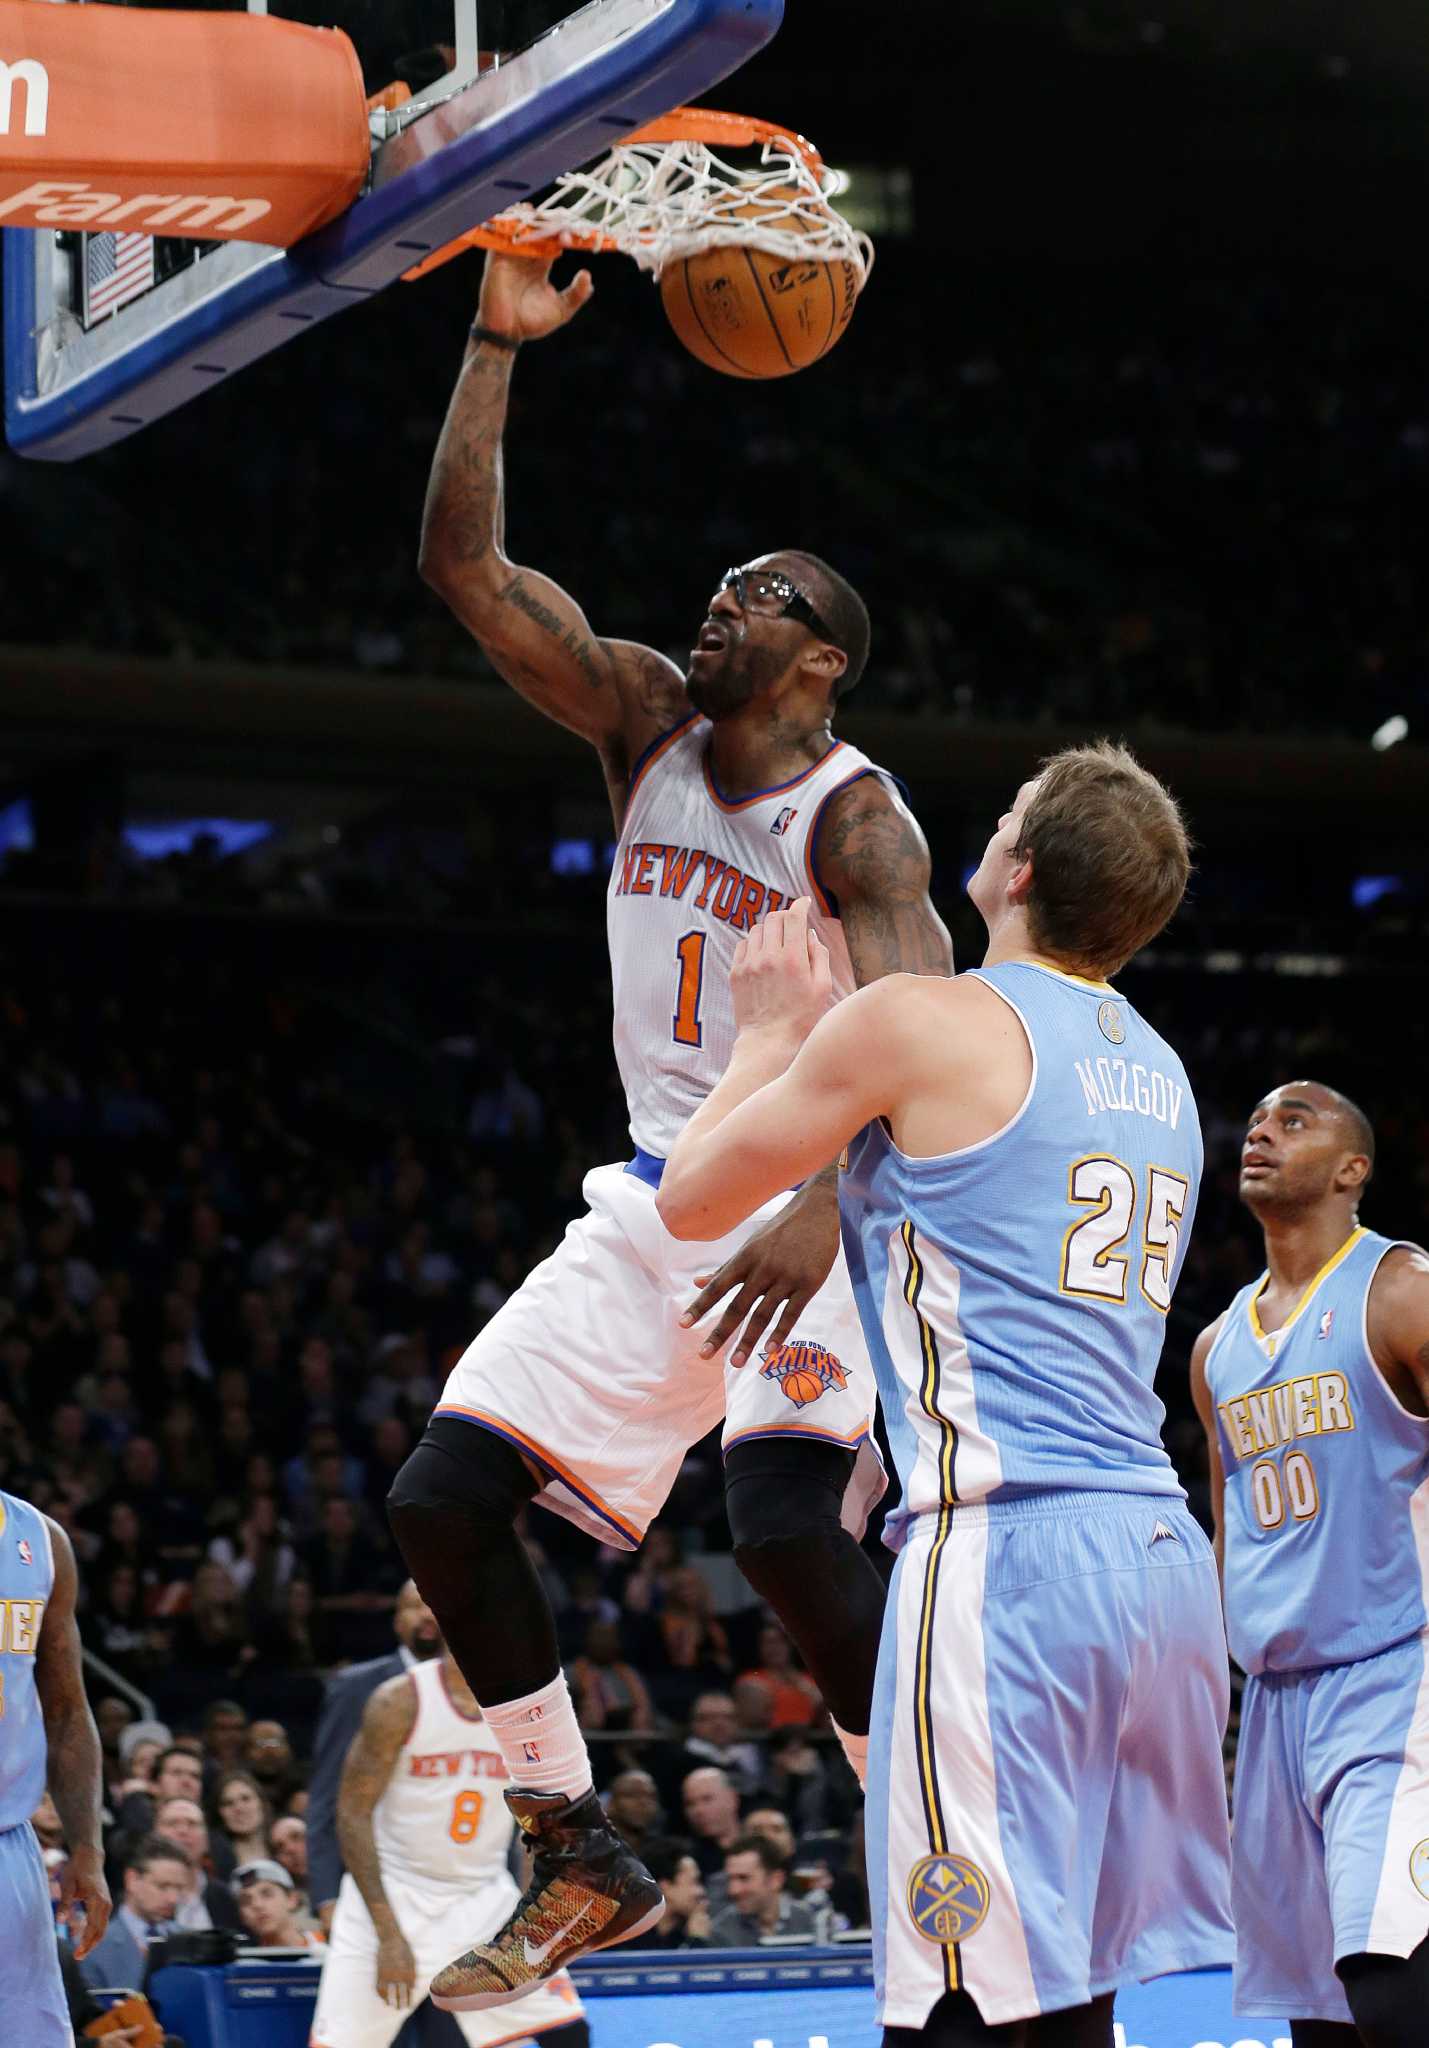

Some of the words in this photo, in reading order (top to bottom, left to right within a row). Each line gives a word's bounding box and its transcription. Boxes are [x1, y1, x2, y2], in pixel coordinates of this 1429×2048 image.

[0, 182, 272, 231] Farm
[615, 842, 705, 899] NEW
[673, 929, 707, 1050] 1
[1074, 1056, 1183, 1131] MOZGOV
[1058, 1152, 1188, 1316] 25
[1251, 1449, 1319, 1532] 00
[448, 1790, 484, 1845] 8
